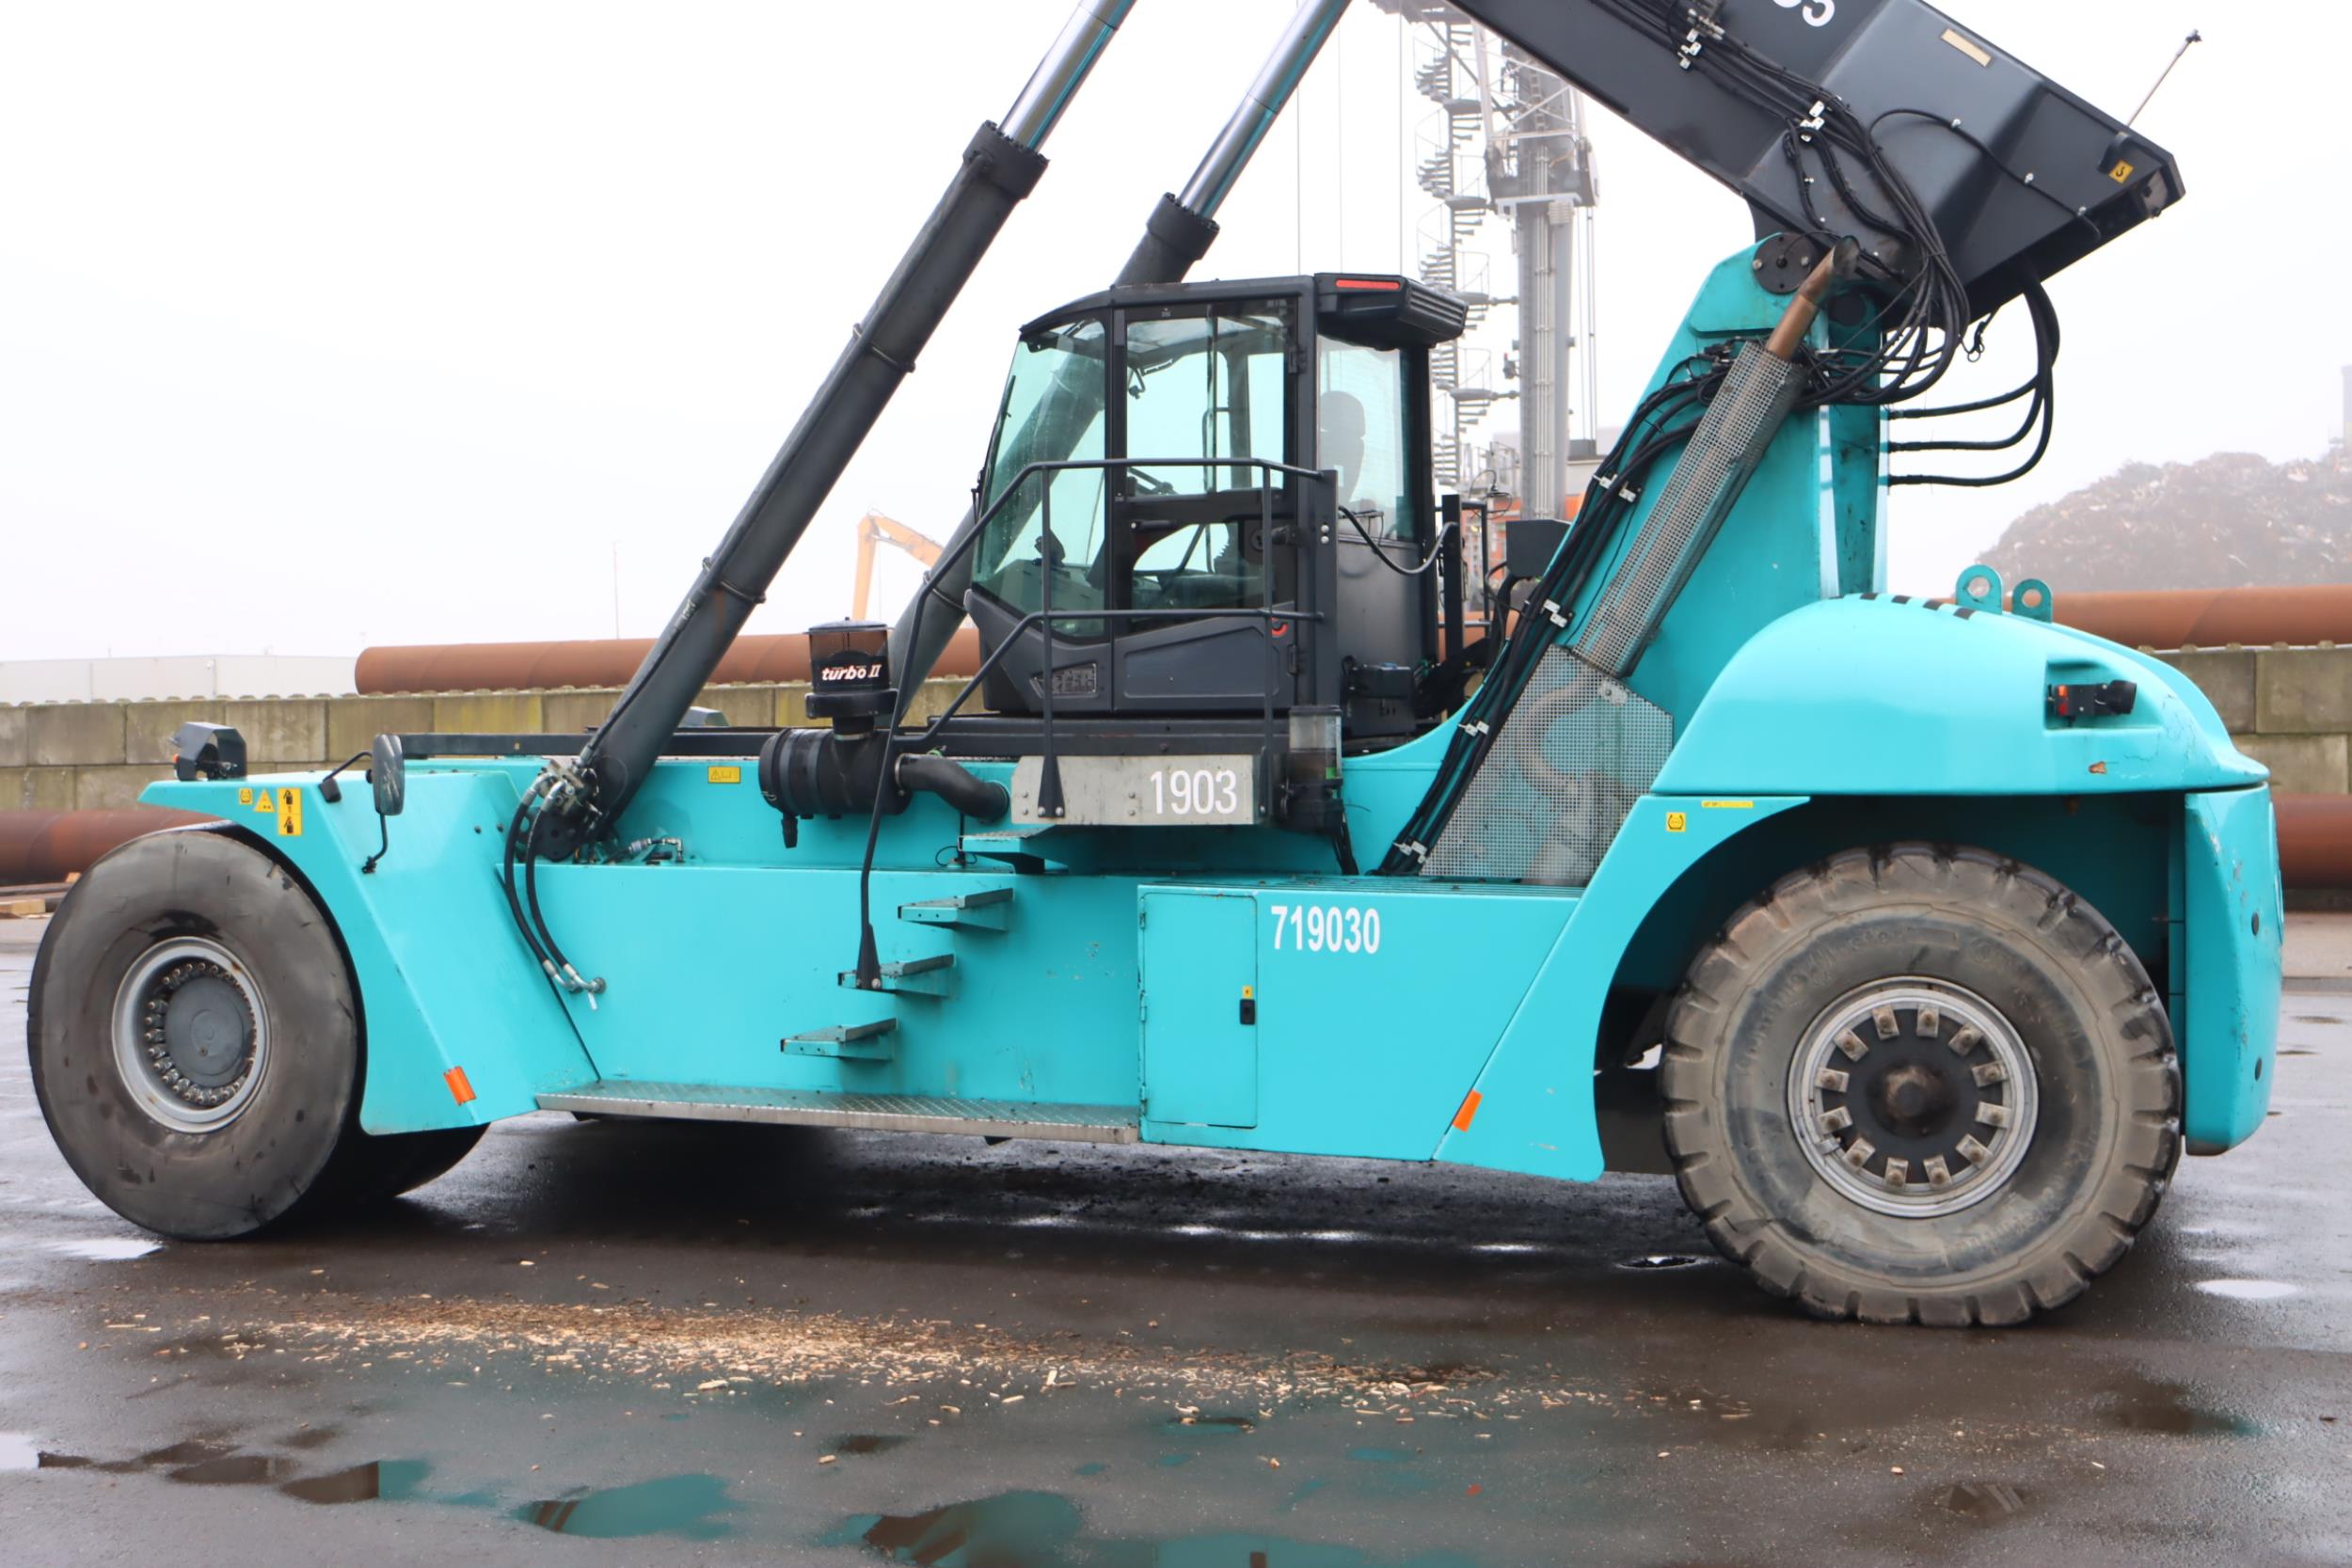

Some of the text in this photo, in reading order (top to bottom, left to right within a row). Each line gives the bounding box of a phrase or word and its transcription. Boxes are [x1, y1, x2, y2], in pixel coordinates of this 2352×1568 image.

[821, 664, 882, 680] turbo II
[1150, 769, 1237, 815] 1903
[1270, 905, 1380, 954] 719030
